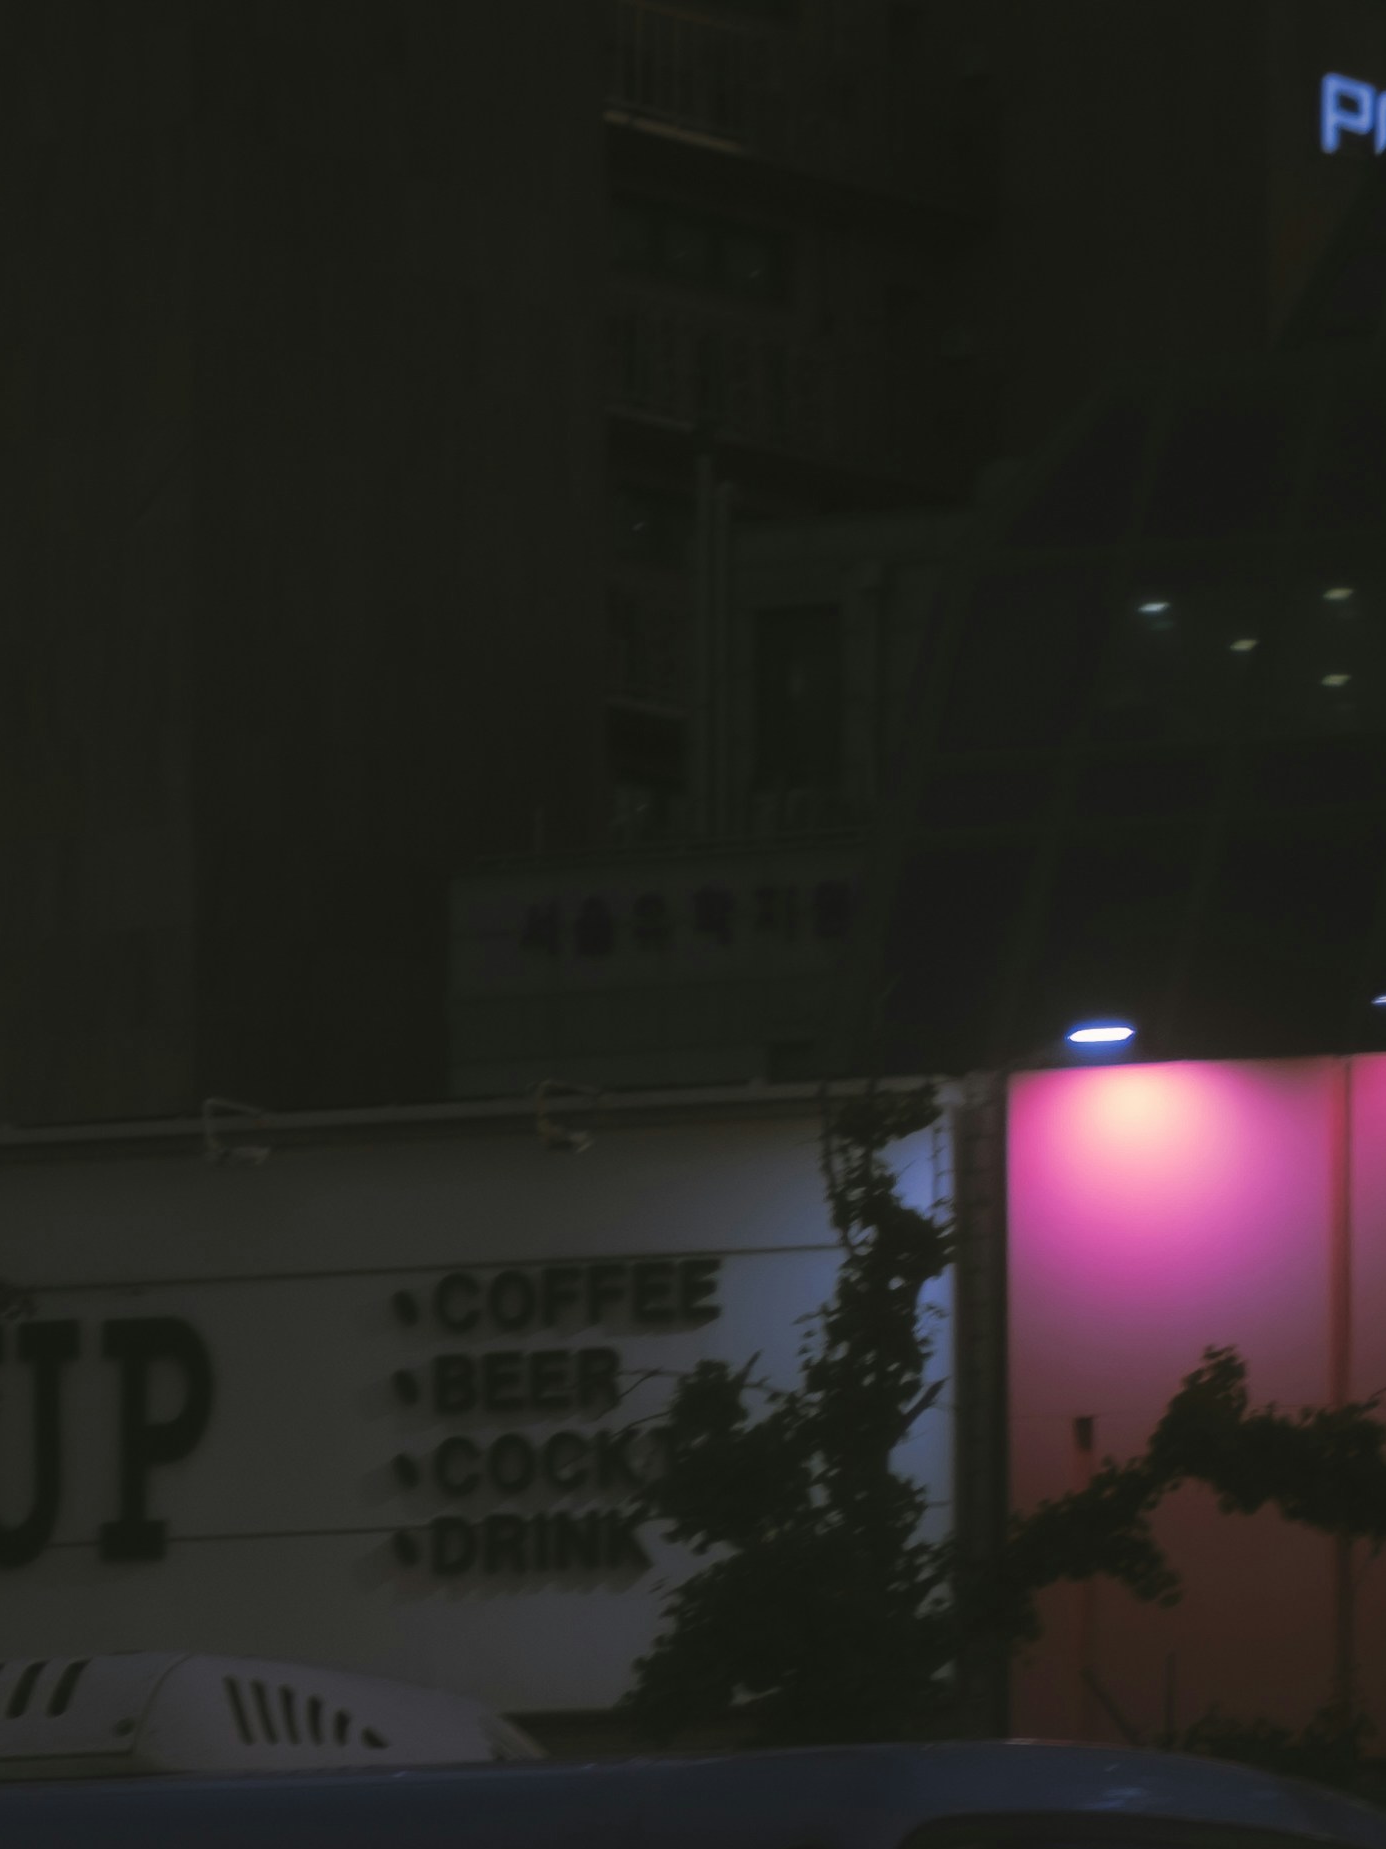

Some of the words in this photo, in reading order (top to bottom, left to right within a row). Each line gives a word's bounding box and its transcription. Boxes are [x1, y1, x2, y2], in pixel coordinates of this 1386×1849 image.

[433, 1257, 722, 1334] COFFEE
[433, 1346, 620, 1414] BEER
[432, 1509, 651, 1577] DRINK
